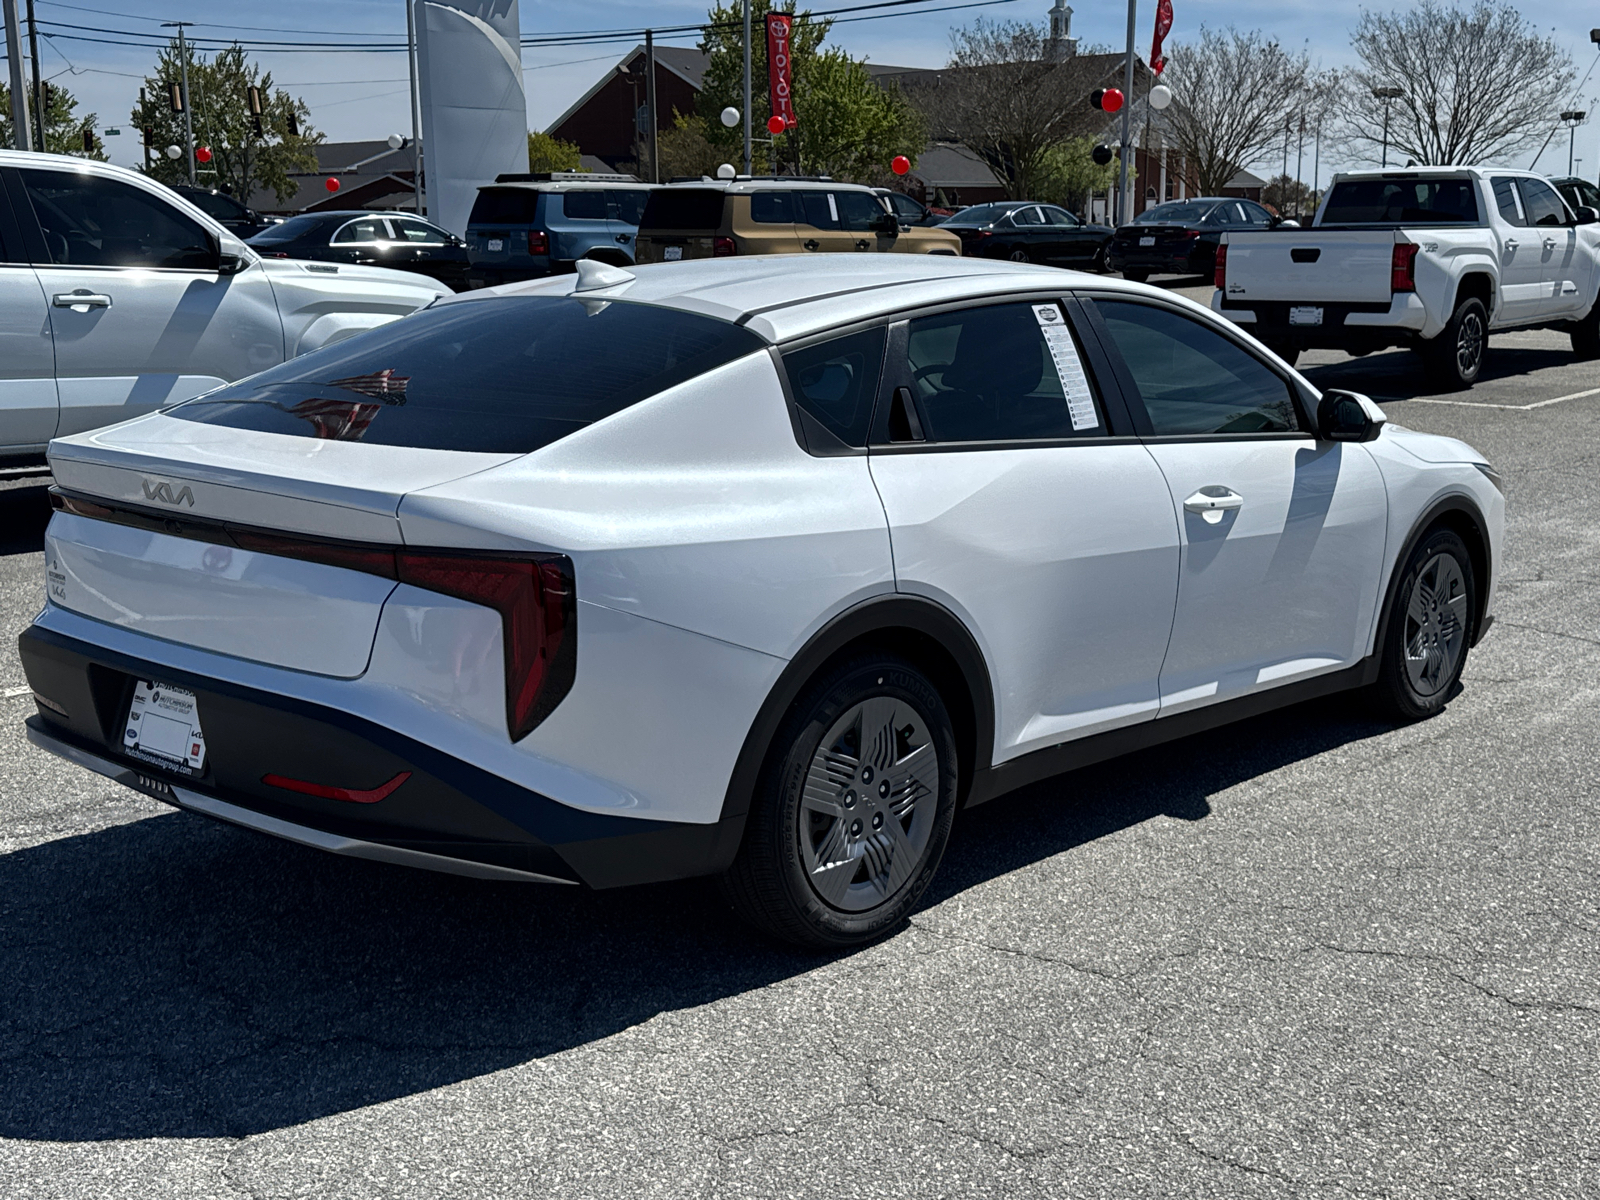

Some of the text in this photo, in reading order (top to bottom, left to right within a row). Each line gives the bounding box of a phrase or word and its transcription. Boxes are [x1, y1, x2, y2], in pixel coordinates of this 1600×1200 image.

[775, 39, 790, 125] TOYOTA
[141, 479, 195, 508] KIA
[52, 584, 66, 600] K4
[888, 672, 937, 710] KUMHO
